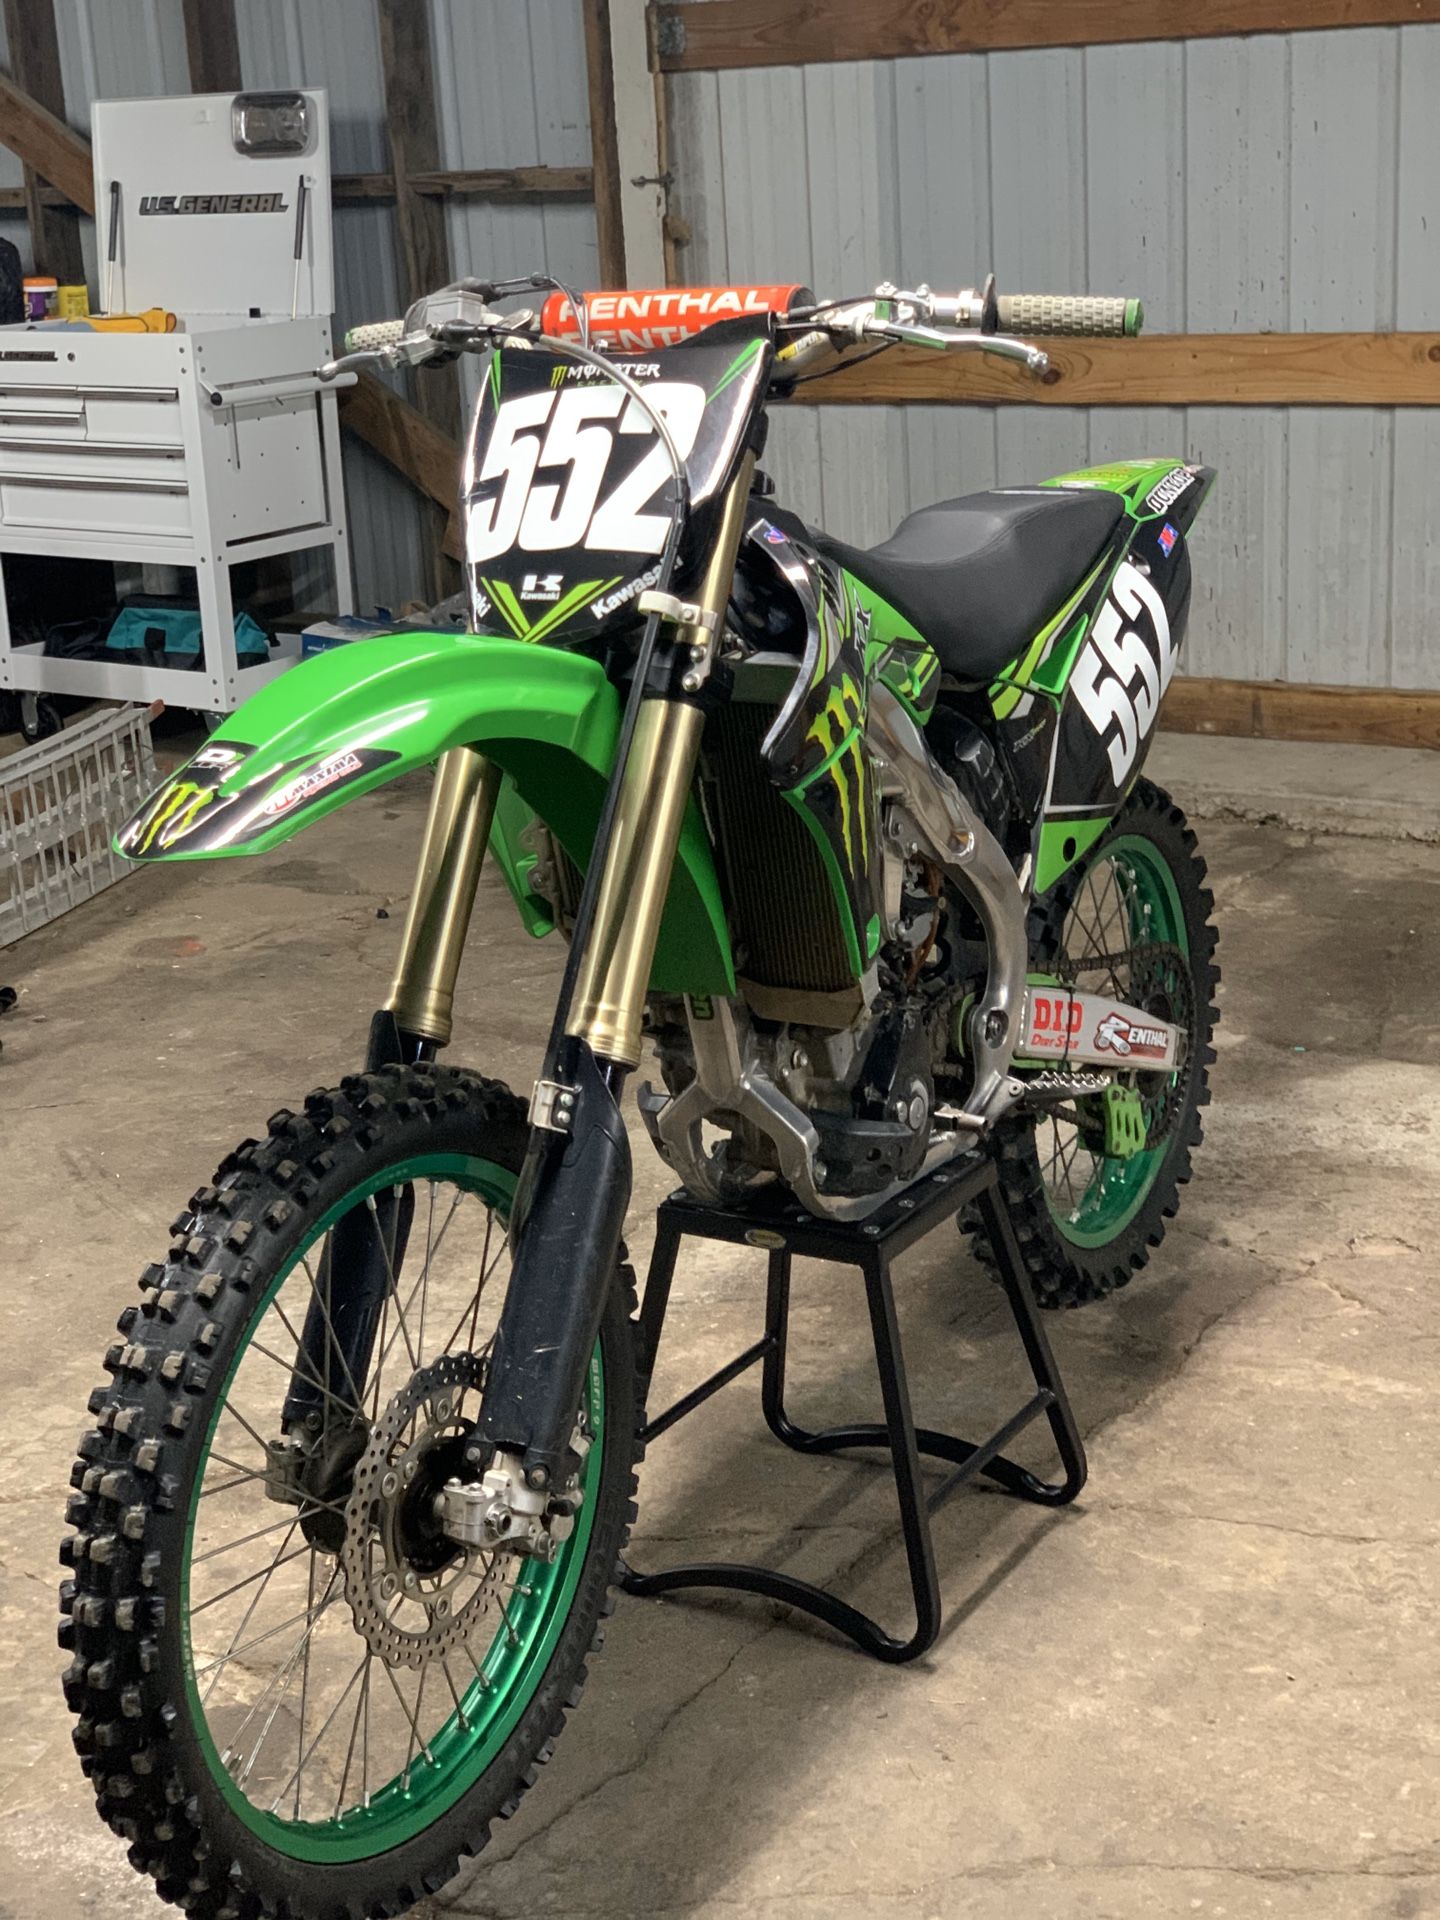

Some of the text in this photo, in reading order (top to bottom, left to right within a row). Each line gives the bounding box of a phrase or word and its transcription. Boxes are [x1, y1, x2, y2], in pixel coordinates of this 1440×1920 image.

[560, 290, 770, 322] RENTHAL
[467, 383, 706, 564] 552
[590, 555, 684, 619] Kawasai
[1068, 561, 1178, 788] 552
[1096, 1013, 1168, 1055] RENTHAL
